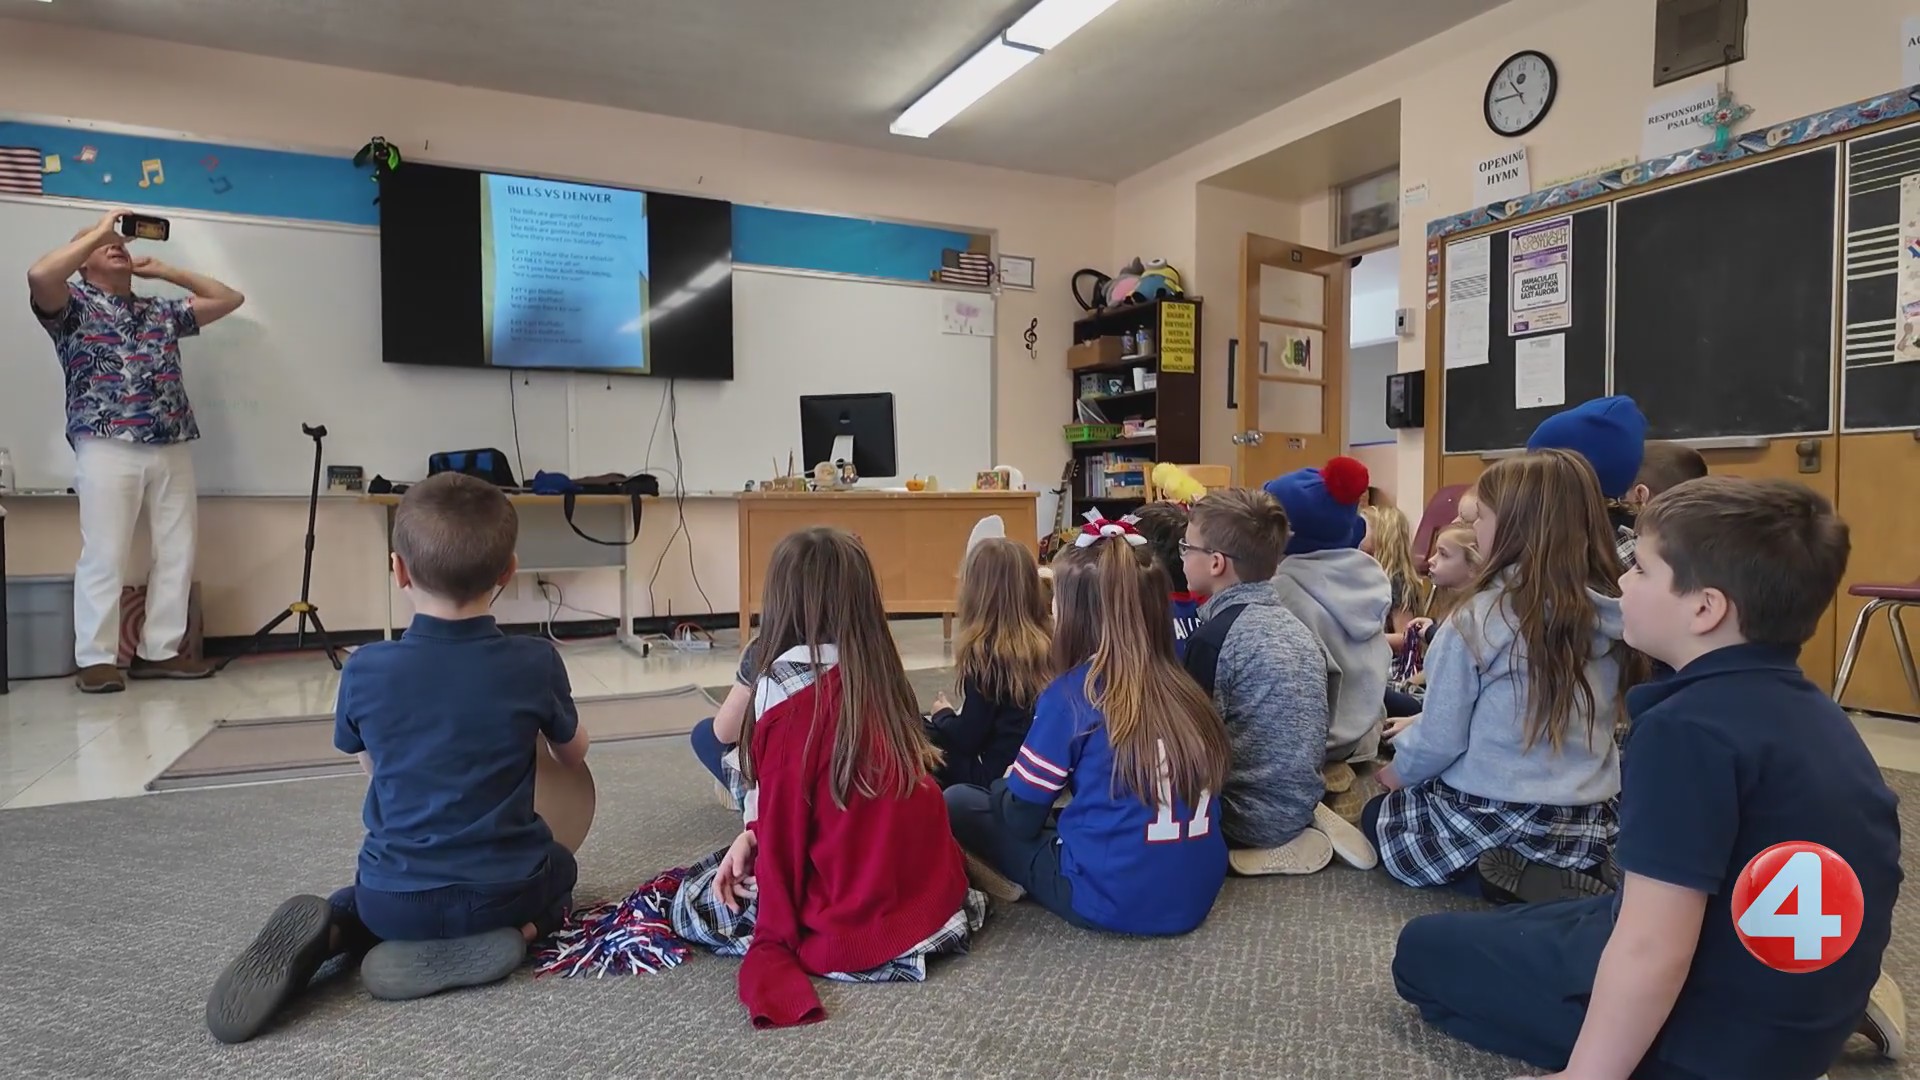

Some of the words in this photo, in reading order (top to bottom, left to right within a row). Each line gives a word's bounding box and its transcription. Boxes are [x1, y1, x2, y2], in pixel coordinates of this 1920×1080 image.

[1648, 98, 1716, 125] RESPONSORIAL
[1479, 149, 1524, 172] OPENING
[1487, 167, 1518, 186] HYMN
[507, 185, 542, 198] BILLS
[544, 188, 560, 199] VS
[563, 190, 612, 204] DENVER
[1522, 228, 1568, 243] COMMUNITY
[1522, 234, 1567, 252] SPOTLIGHT
[1521, 280, 1558, 292] CONCEPTION
[1522, 272, 1558, 286] IMMACULATE
[1520, 291, 1534, 300] EAST
[1535, 287, 1559, 297] AURORA
[1173, 617, 1203, 640] ALL
